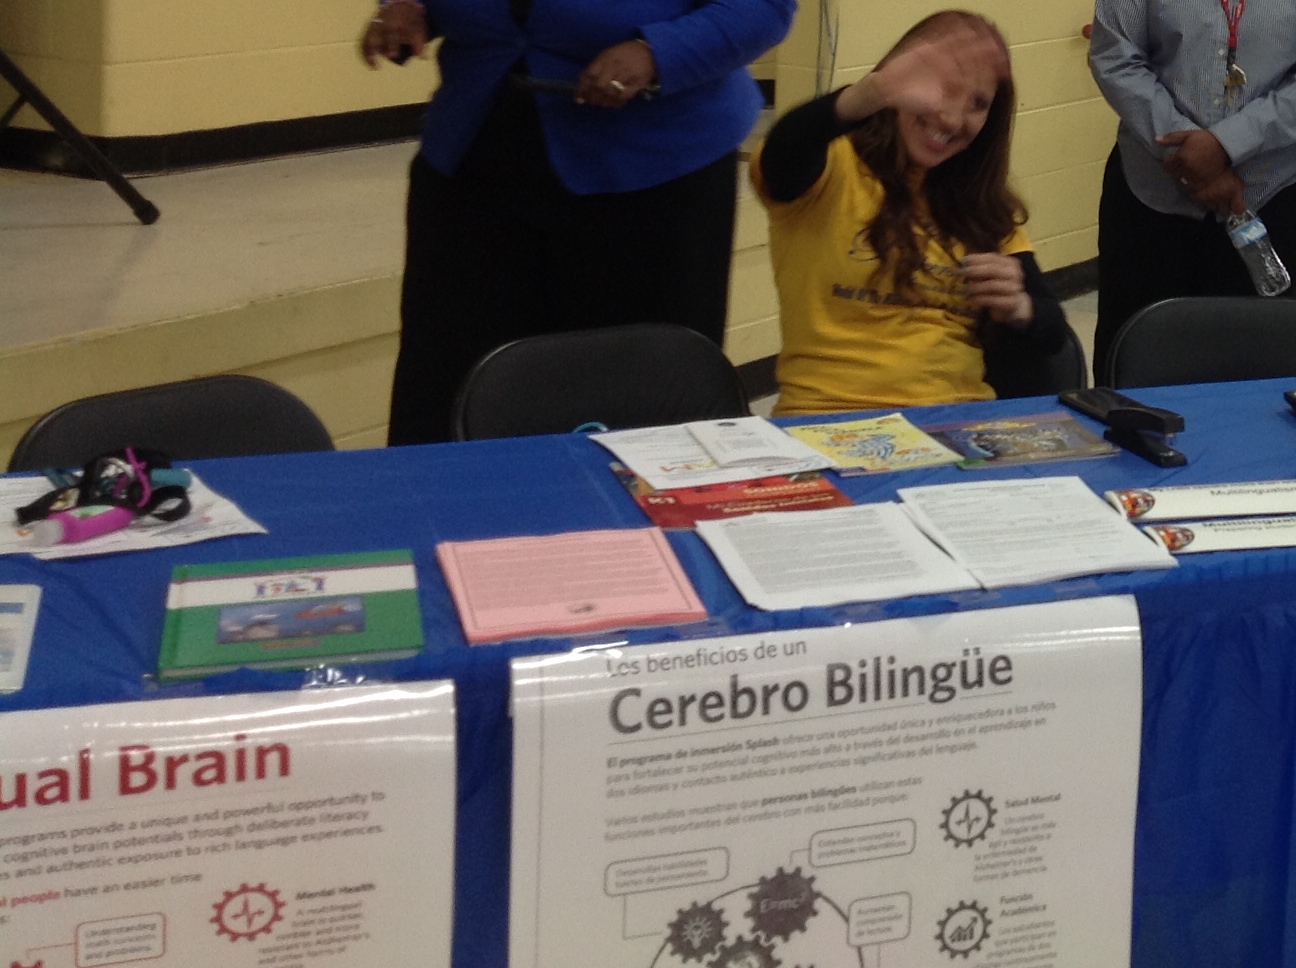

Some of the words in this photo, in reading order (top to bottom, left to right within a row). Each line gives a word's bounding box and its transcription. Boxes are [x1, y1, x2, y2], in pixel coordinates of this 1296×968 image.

[606, 659, 640, 678] Los
[647, 647, 748, 673] beneficios
[754, 641, 778, 660] de
[783, 640, 807, 655] un
[609, 673, 809, 734] Cerebro
[826, 646, 1013, 707] Bilingüe
[0, 748, 91, 811] ual
[119, 733, 291, 797] Brain
